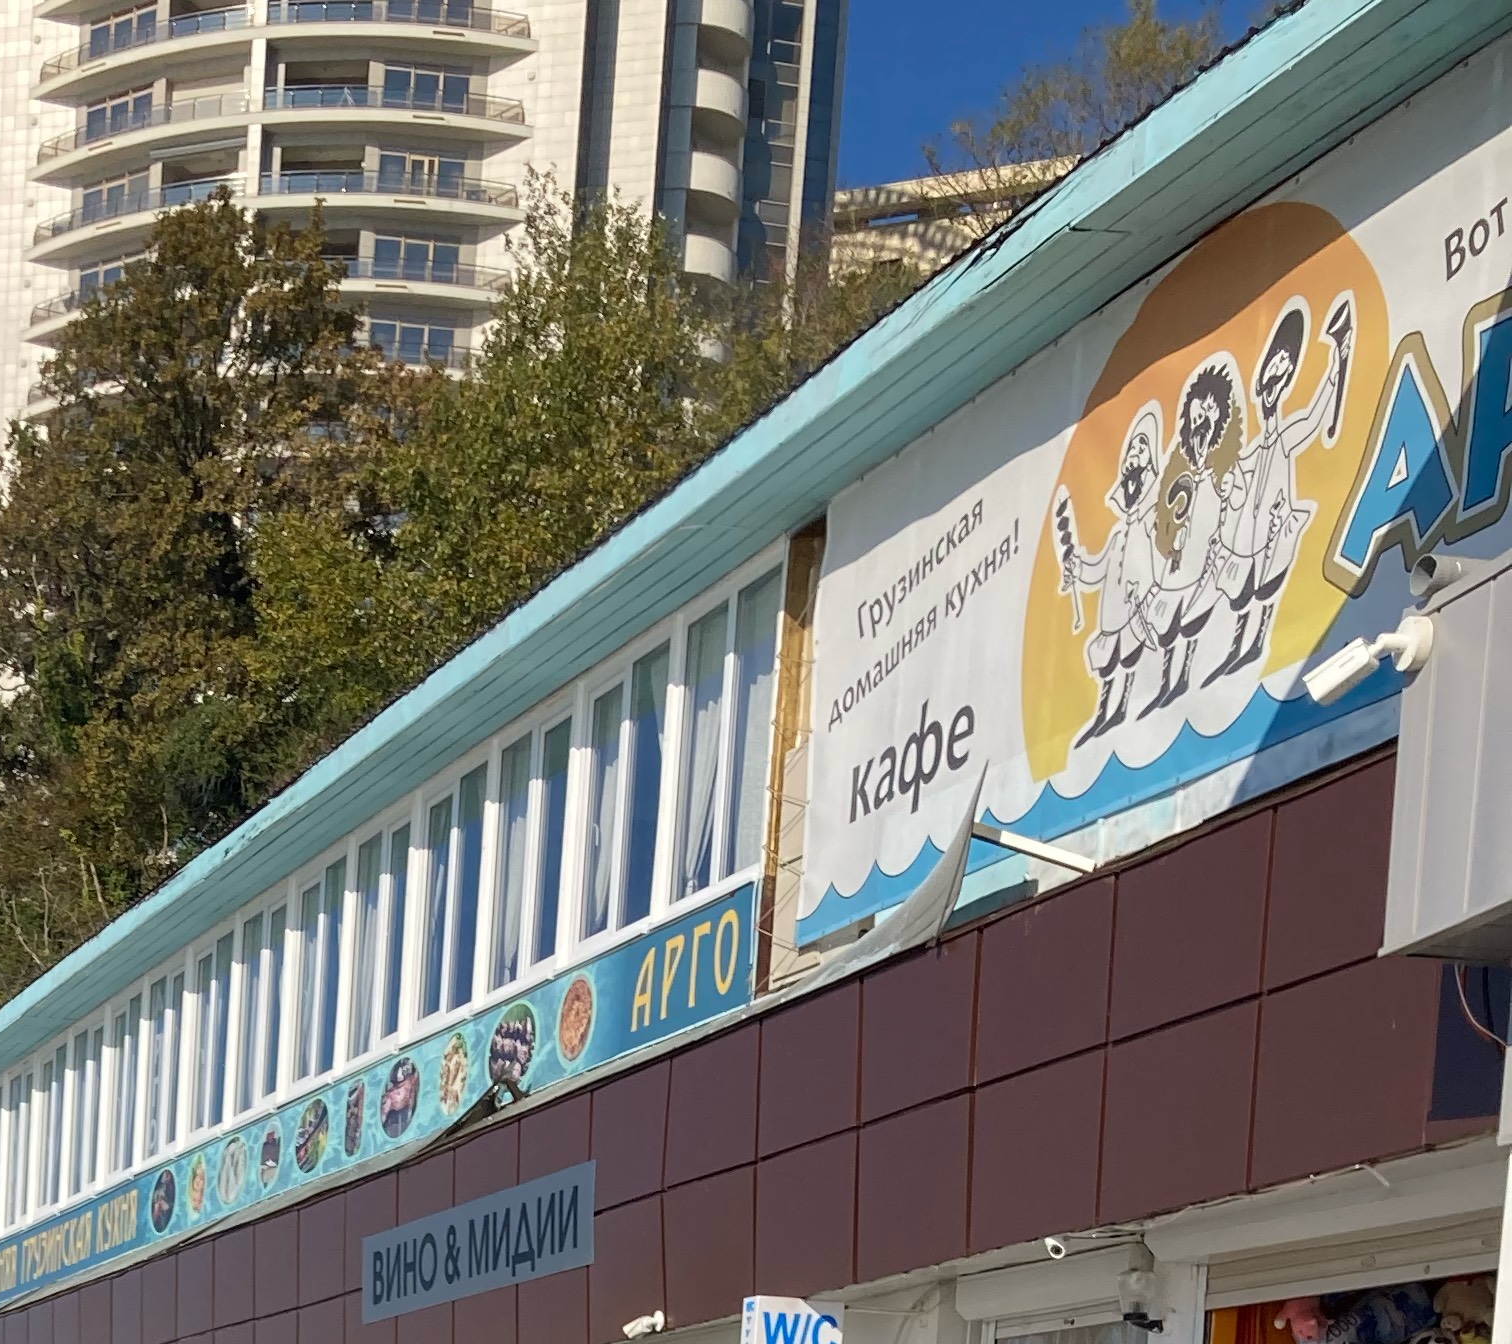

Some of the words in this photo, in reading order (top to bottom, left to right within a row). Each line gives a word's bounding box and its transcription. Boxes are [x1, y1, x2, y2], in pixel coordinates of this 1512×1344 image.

[1444, 197, 1508, 281] Вот
[828, 605, 937, 732] домашняя
[945, 518, 1019, 618] кухня!
[857, 498, 983, 639] Грузинская
[849, 699, 975, 824] кафе
[630, 909, 740, 1032] АРГО
[373, 1232, 437, 1305] ВИНО
[444, 1224, 461, 1285] &
[468, 1185, 579, 1277] МИДИИ
